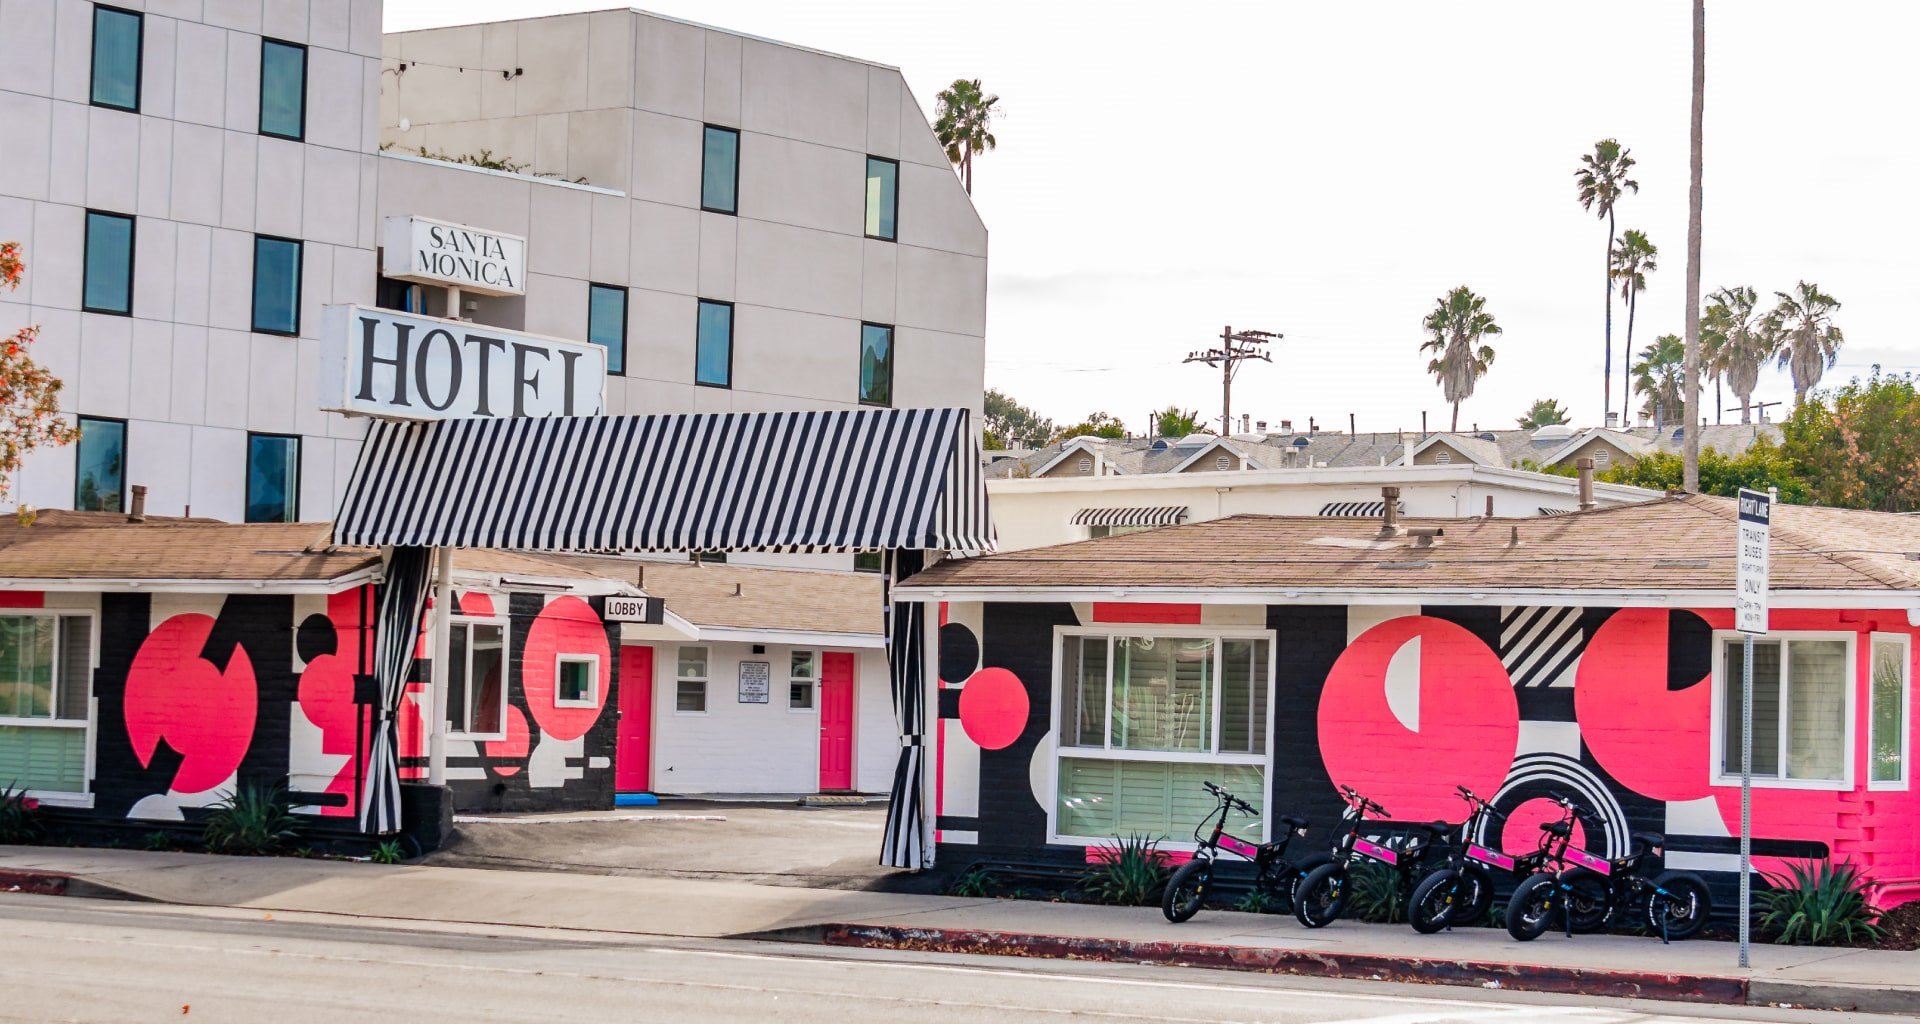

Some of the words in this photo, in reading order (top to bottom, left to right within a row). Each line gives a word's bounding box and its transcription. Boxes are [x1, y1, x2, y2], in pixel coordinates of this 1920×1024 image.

[430, 226, 506, 260] SANTA
[418, 250, 514, 288] MONICA
[354, 316, 600, 418] HOTEL
[1740, 497, 1756, 515] RIGHT
[1756, 501, 1768, 518] LANE
[1742, 528, 1765, 543] TRANSIT
[1745, 544, 1762, 559] BUSES
[1744, 578, 1760, 595] ONLY
[608, 602, 643, 616] LOBBY
